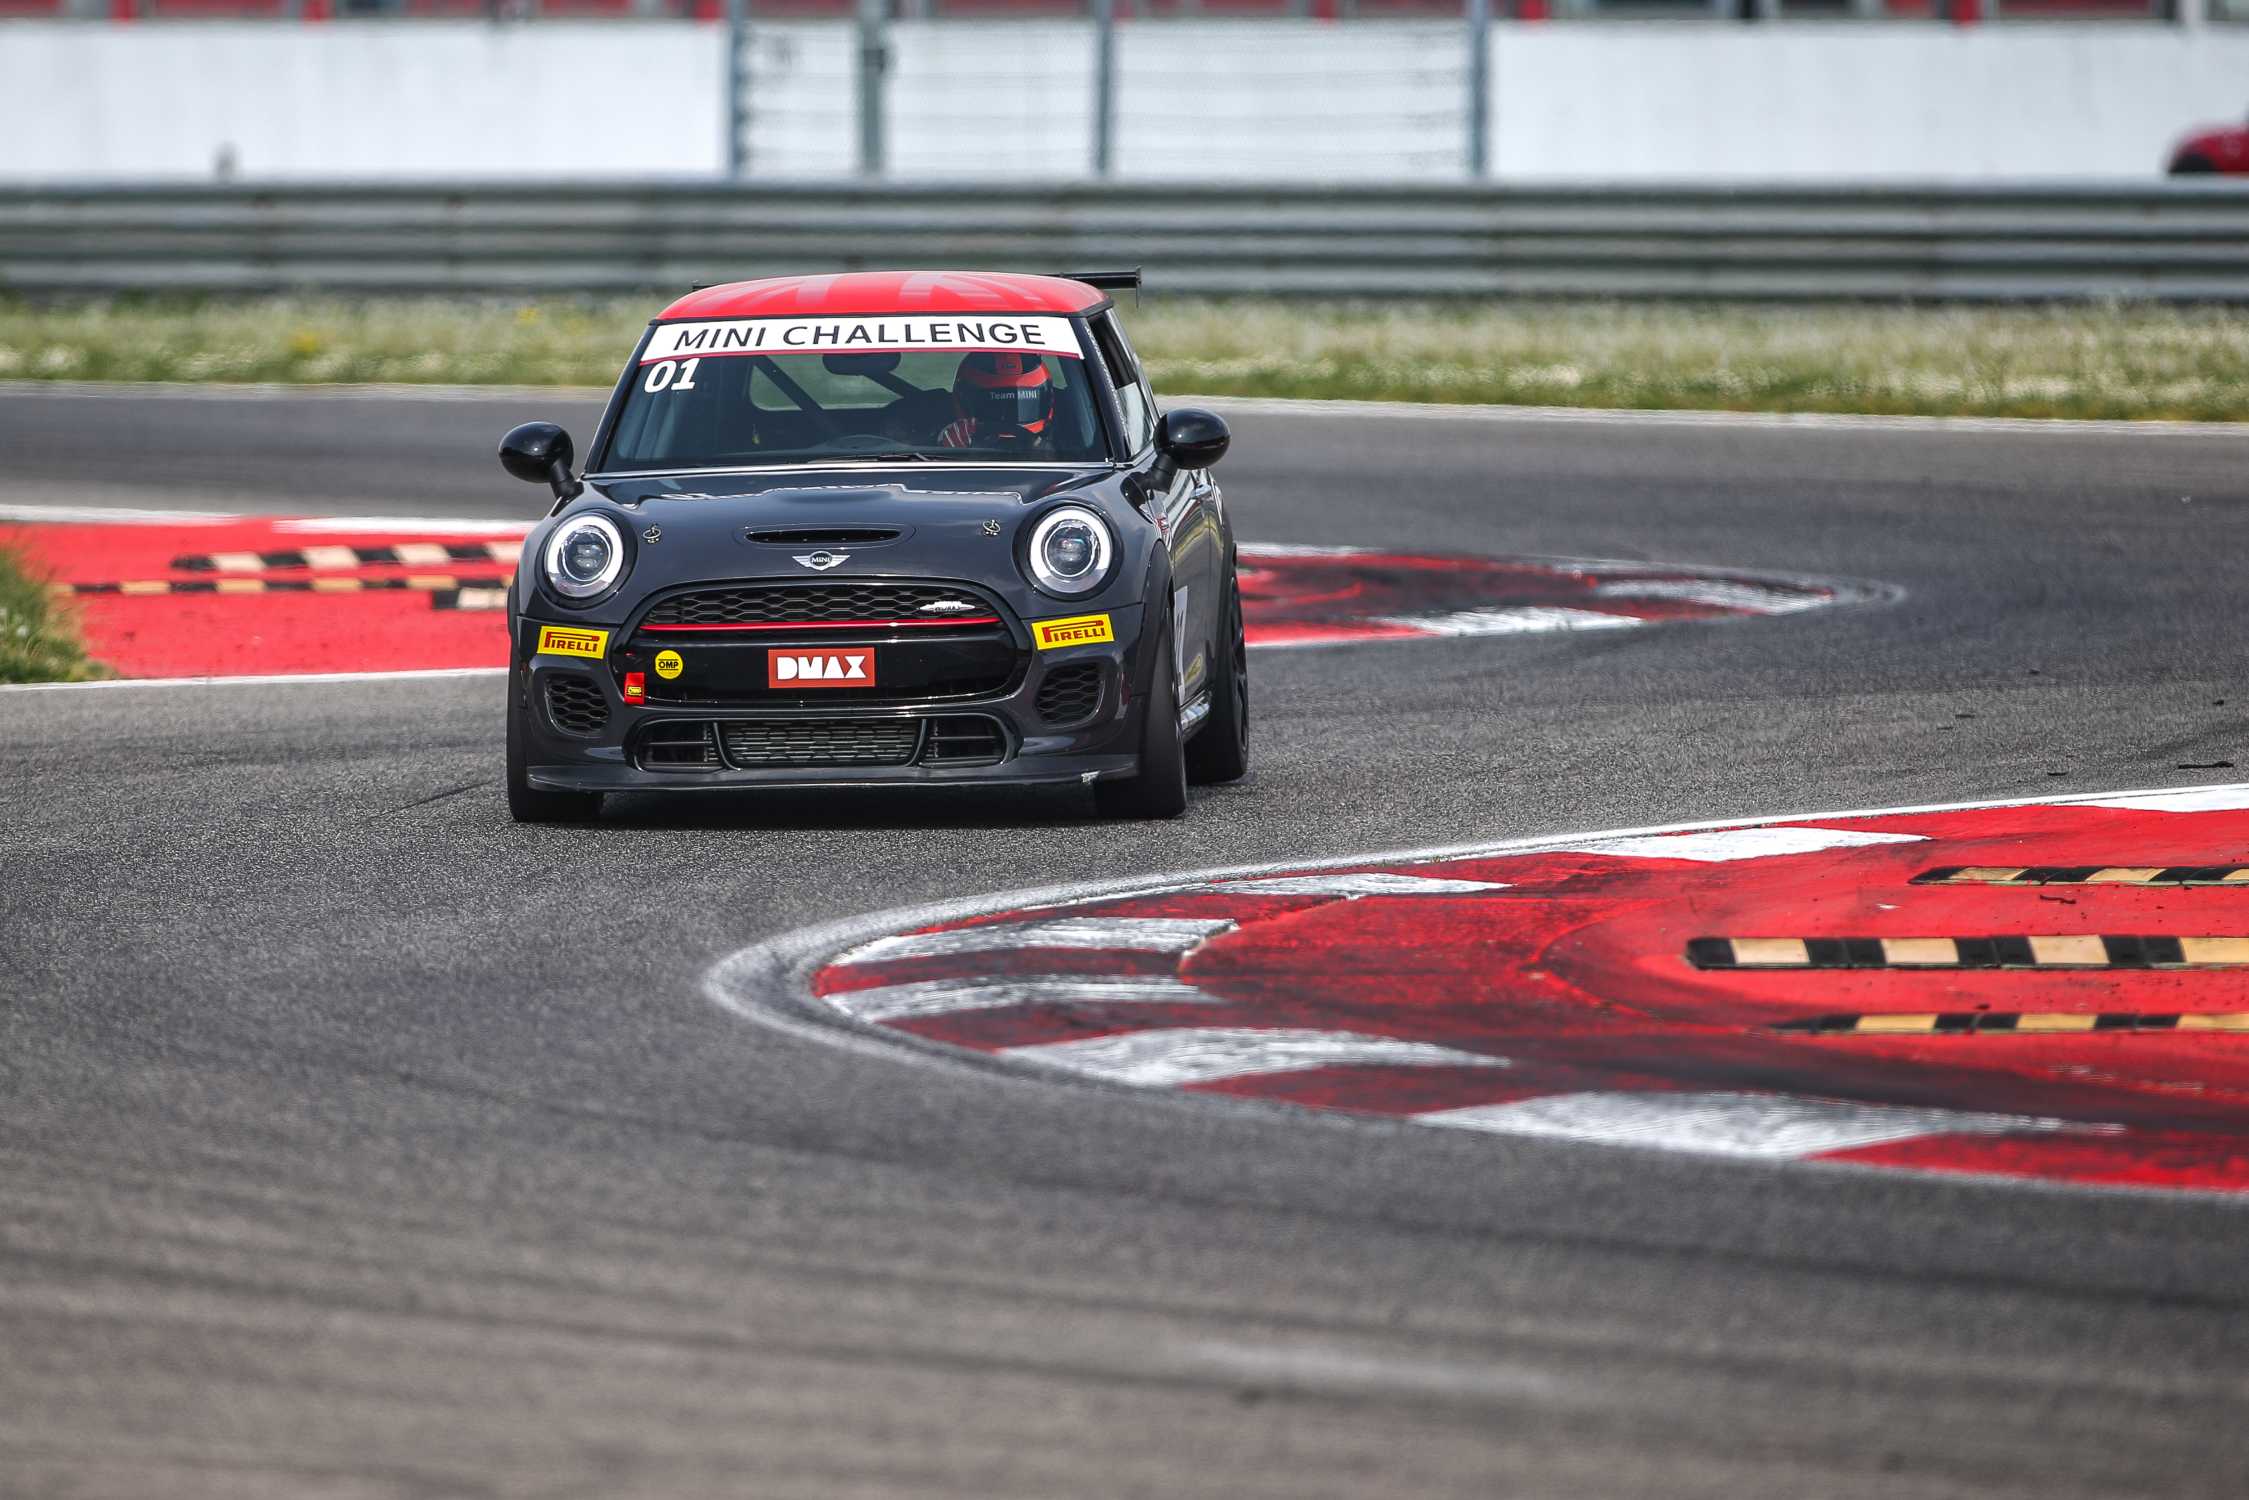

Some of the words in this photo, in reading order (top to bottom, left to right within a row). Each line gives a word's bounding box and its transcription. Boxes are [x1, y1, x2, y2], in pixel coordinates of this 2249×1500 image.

[673, 327, 766, 351] MINI
[782, 322, 1046, 347] CHALLENGE
[644, 357, 700, 393] 01
[544, 631, 600, 652] PIRELLI
[1042, 620, 1106, 643] PIRELLI
[658, 661, 679, 669] OMP
[776, 656, 867, 680] DMAX
